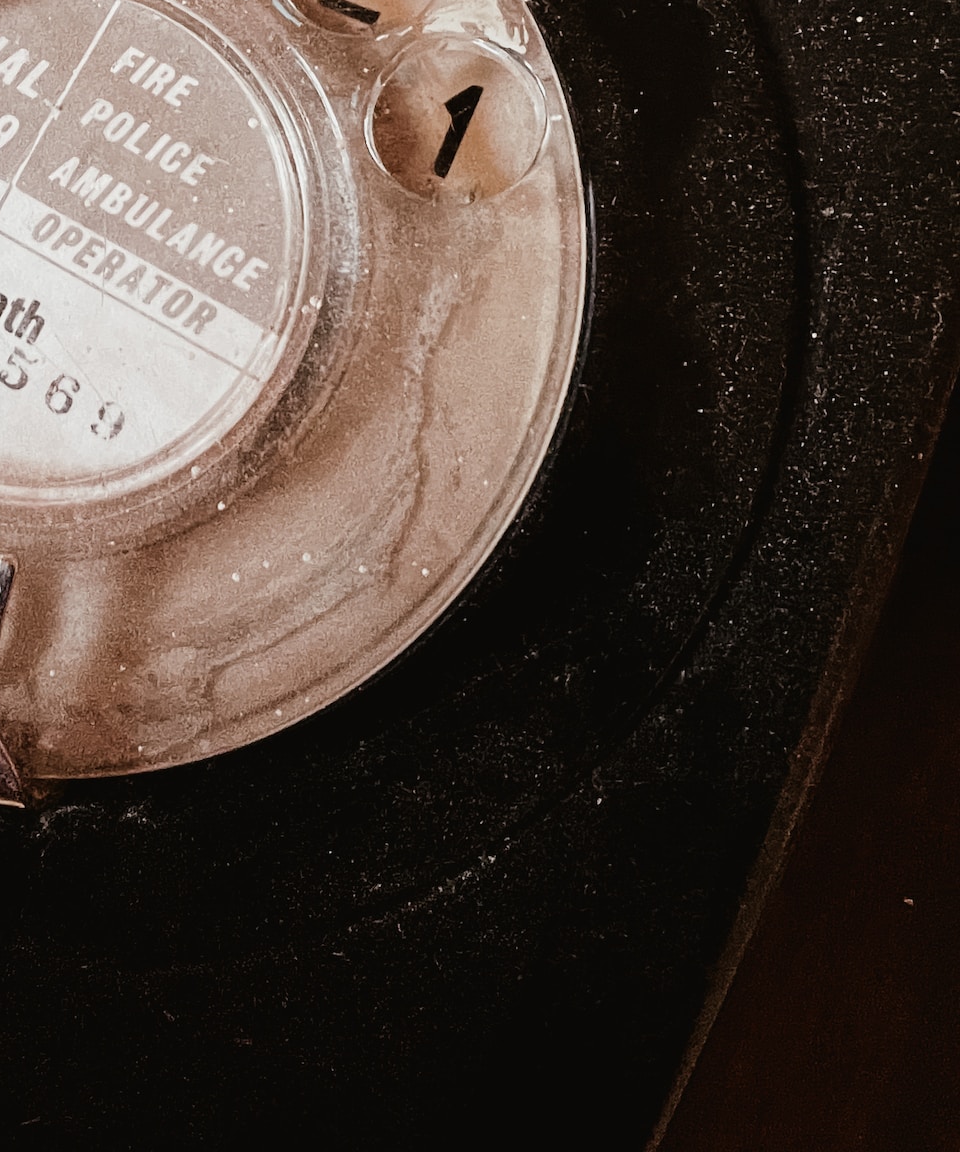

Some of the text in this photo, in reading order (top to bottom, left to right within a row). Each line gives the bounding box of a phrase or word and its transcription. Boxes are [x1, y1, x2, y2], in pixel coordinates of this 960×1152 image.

[110, 46, 199, 108] FIRE
[80, 98, 214, 186] POLICE
[434, 85, 483, 179] 1
[48, 157, 268, 291] AMBULANCE
[32, 213, 217, 335] OPERATOR
